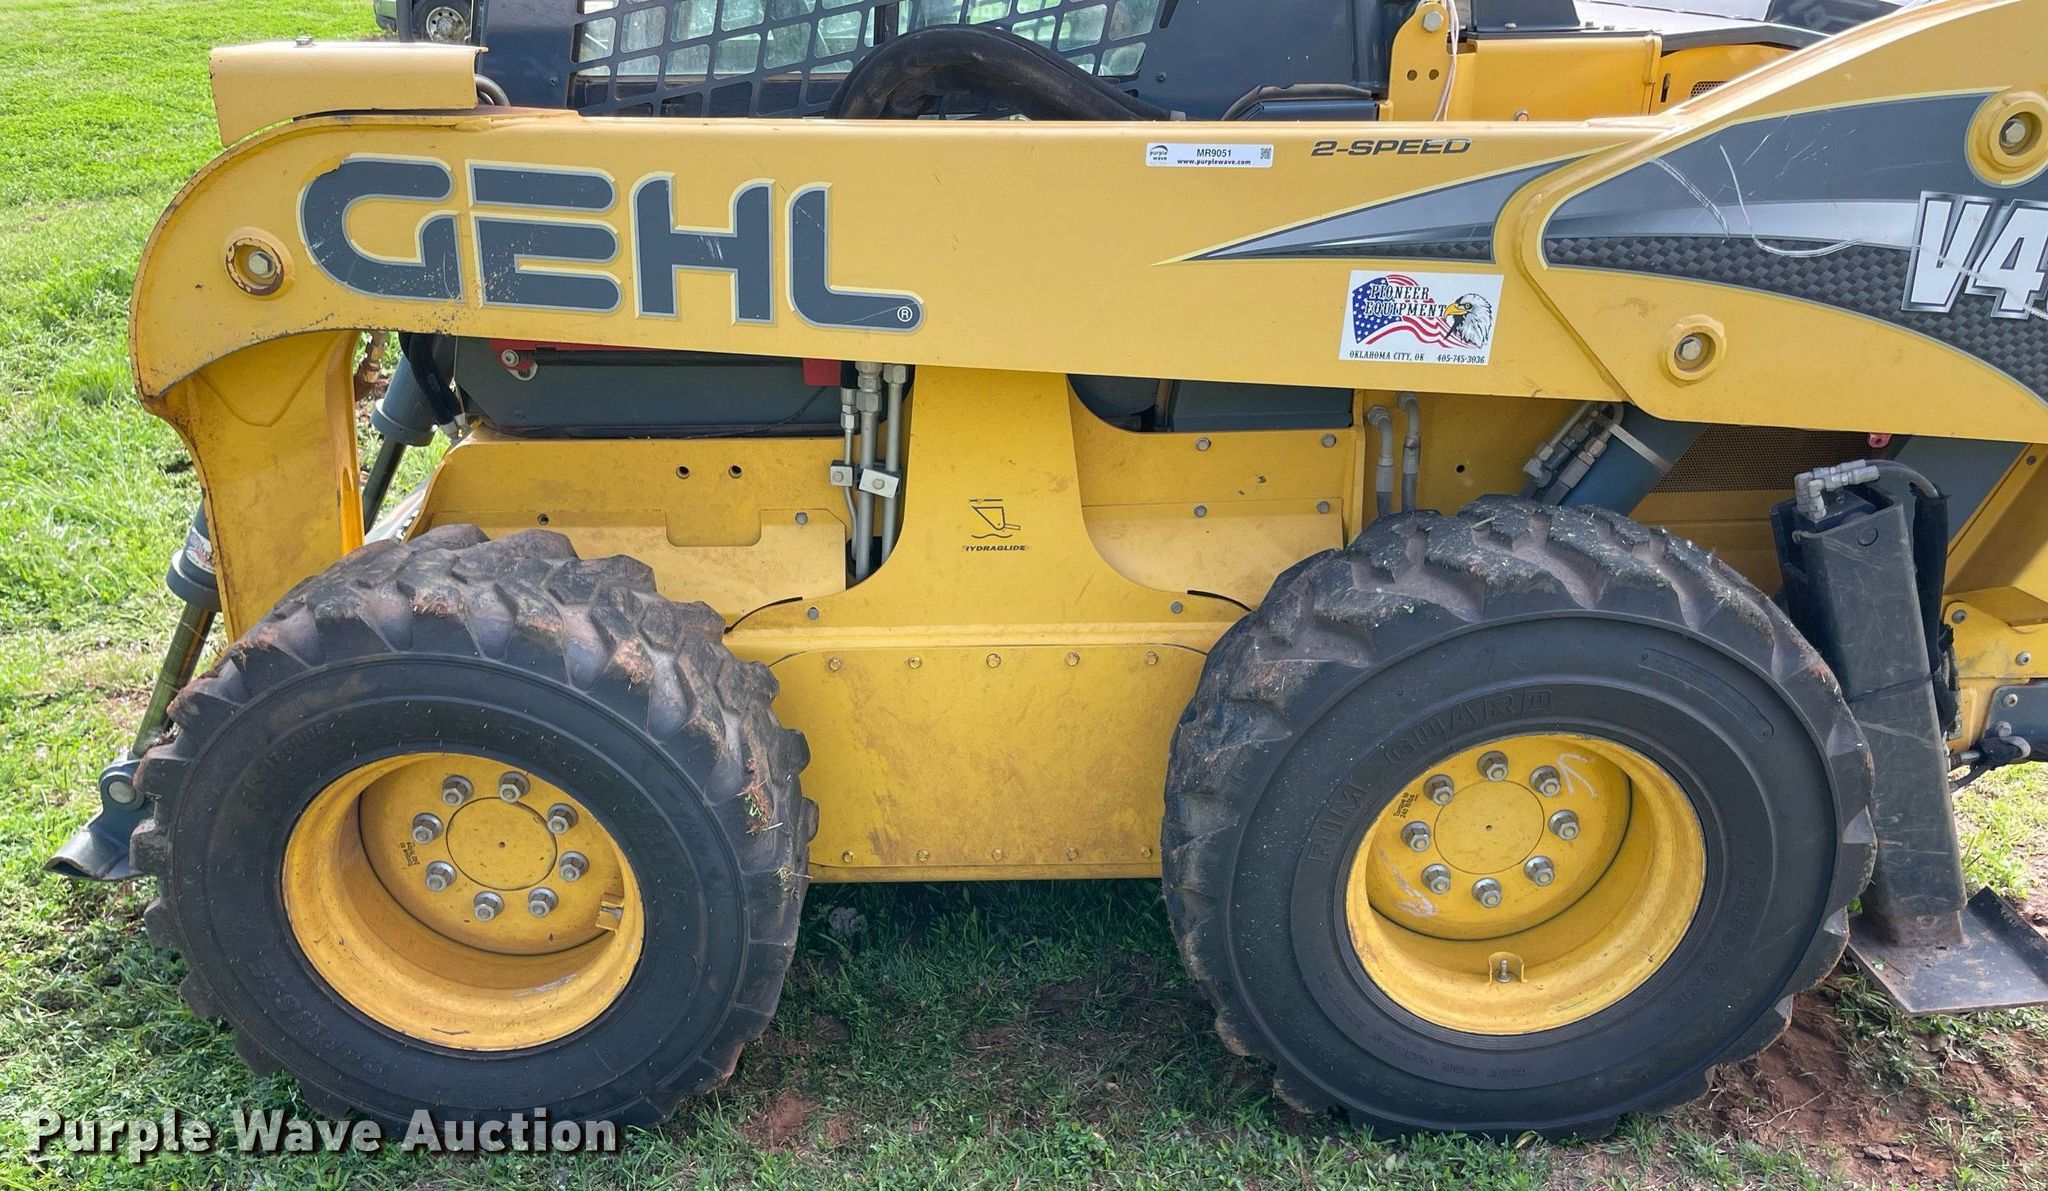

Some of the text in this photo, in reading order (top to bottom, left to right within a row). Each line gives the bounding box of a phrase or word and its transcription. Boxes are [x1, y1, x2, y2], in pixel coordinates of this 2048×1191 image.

[1196, 148, 1232, 158] MR9051
[1311, 138, 1472, 157] 2-SPEED
[1369, 284, 1430, 300] PIONEER
[1364, 300, 1447, 317] EQUIPMENT
[1349, 350, 1425, 362] OKLAHOMA CITY, OK
[1436, 354, 1485, 364] 405-745-3036
[1384, 688, 1555, 766] GUARD
